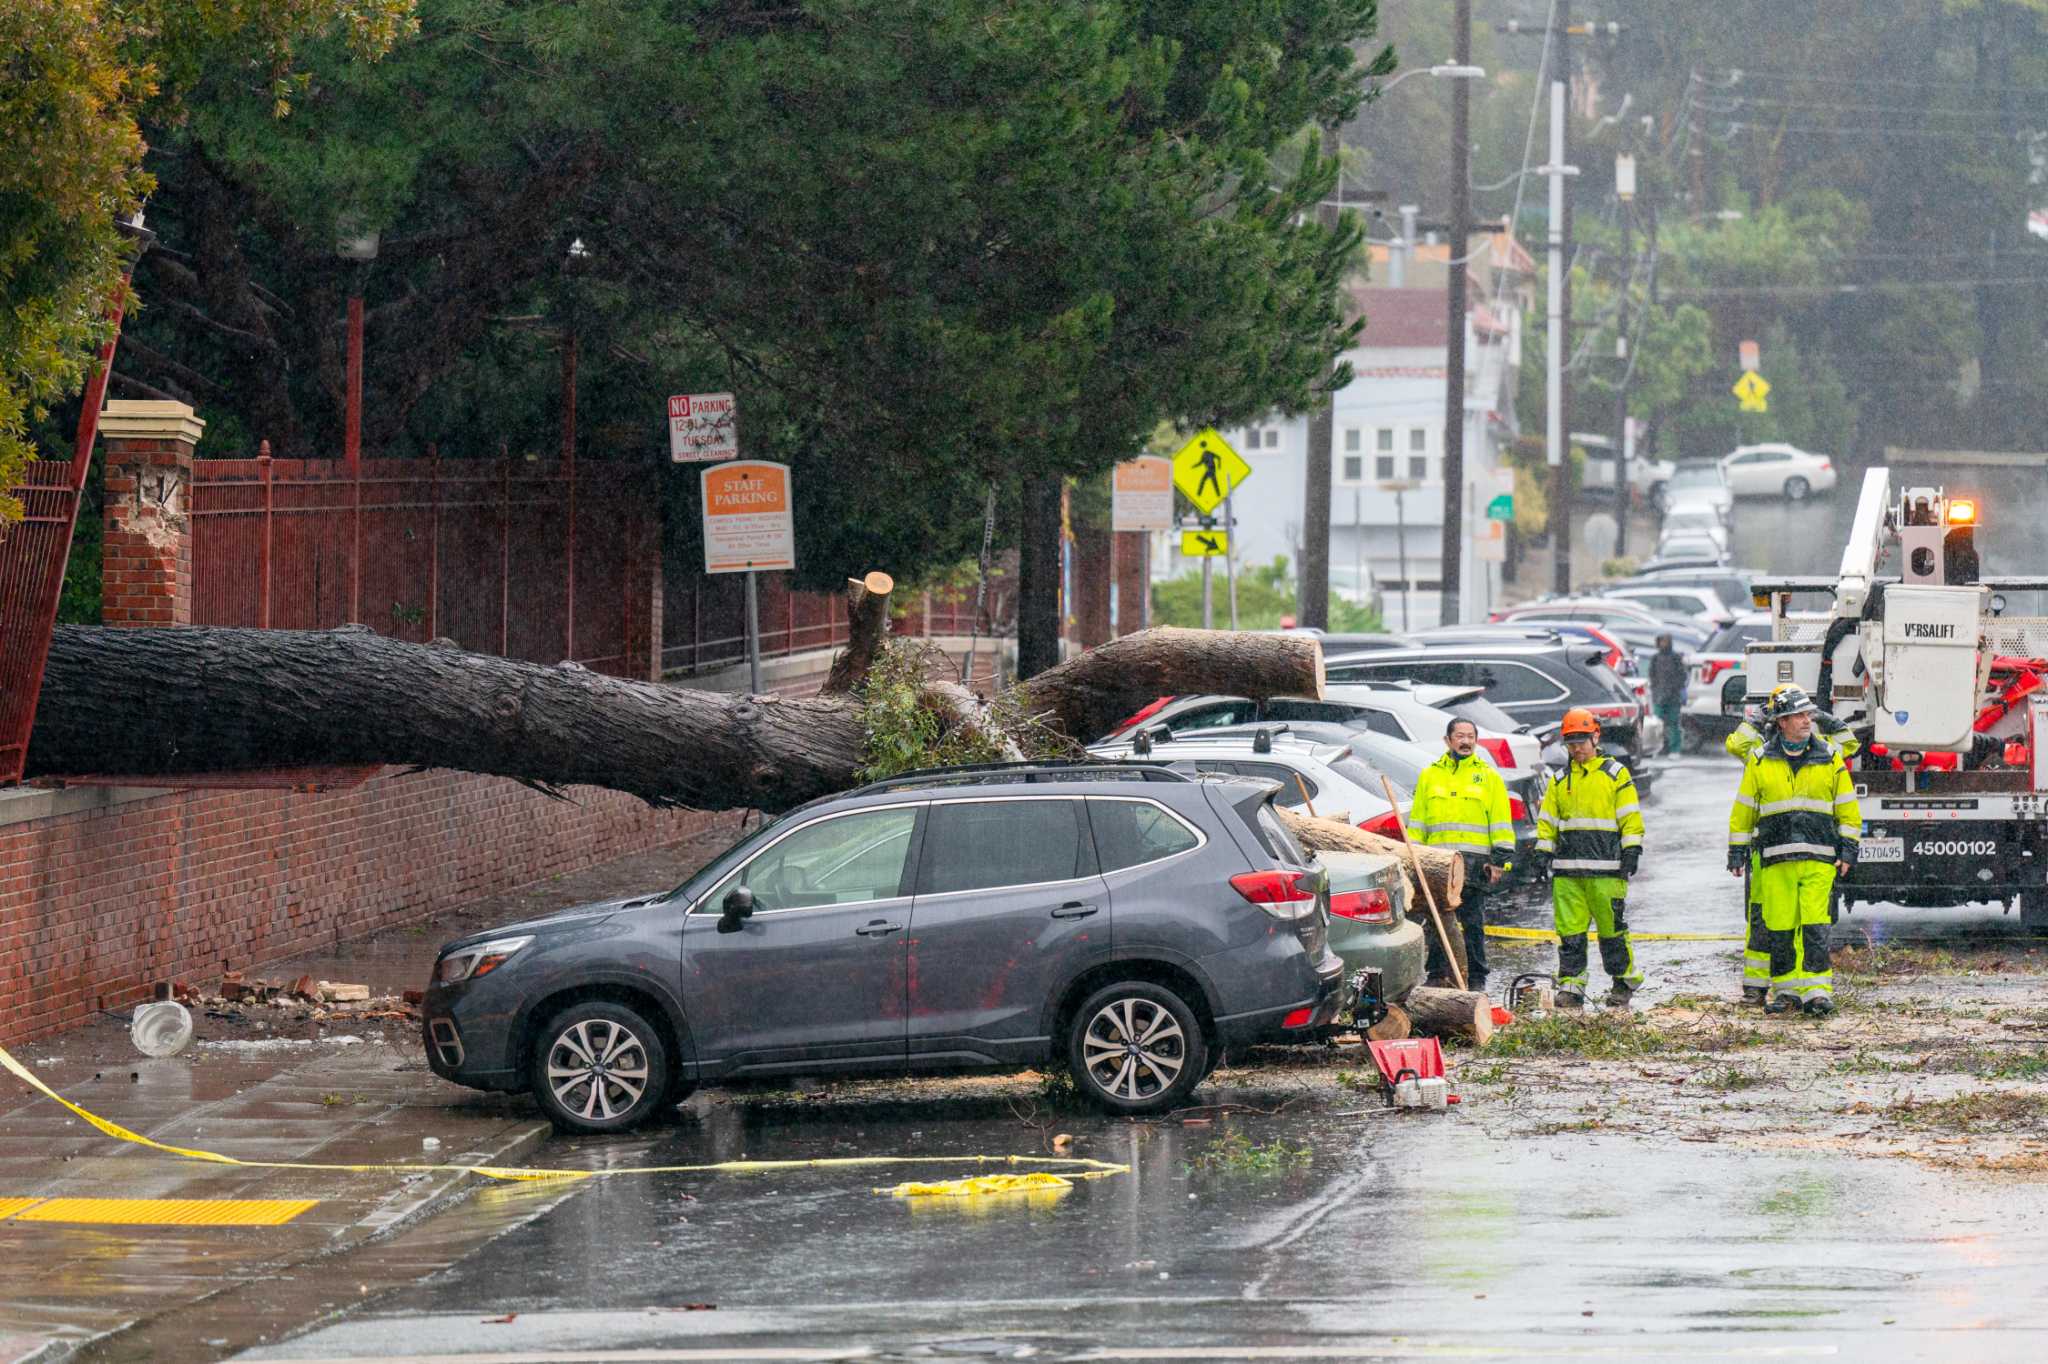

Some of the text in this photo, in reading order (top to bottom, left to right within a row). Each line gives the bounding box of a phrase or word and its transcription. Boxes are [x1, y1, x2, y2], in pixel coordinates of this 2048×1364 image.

[671, 398, 731, 416] NO PARKING
[723, 479, 765, 492] STAFF
[714, 490, 778, 506] PARKING
[1904, 623, 1955, 639] VERSALIFT
[1913, 841, 1996, 856] 45000102
